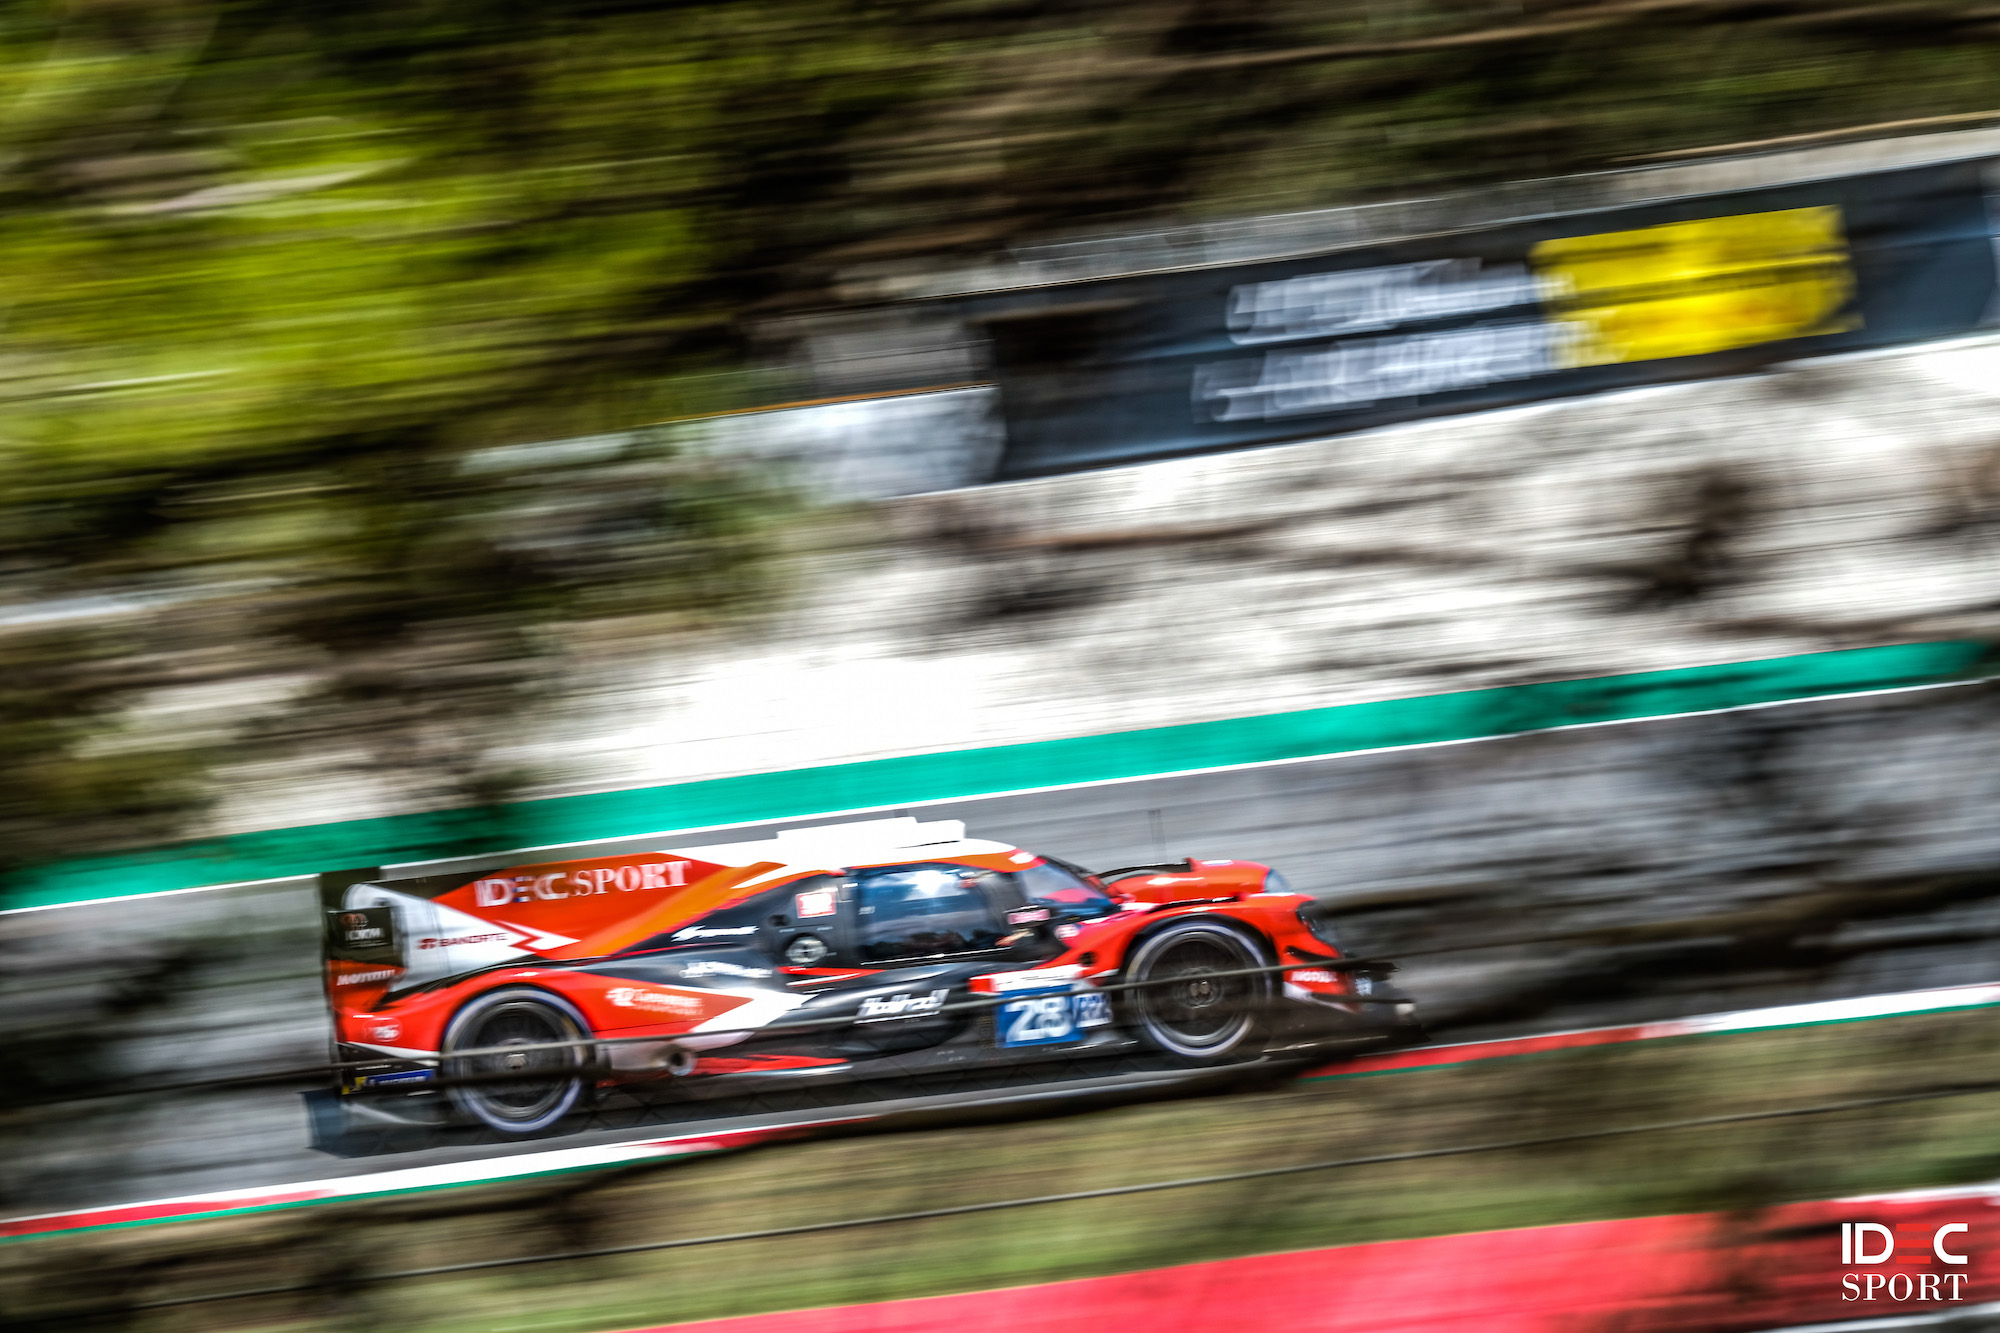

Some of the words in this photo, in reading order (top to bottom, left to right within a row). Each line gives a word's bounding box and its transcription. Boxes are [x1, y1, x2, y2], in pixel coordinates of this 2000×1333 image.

[474, 873, 569, 907] IDEC
[570, 860, 691, 897] SPORT
[1004, 992, 1072, 1043] 28
